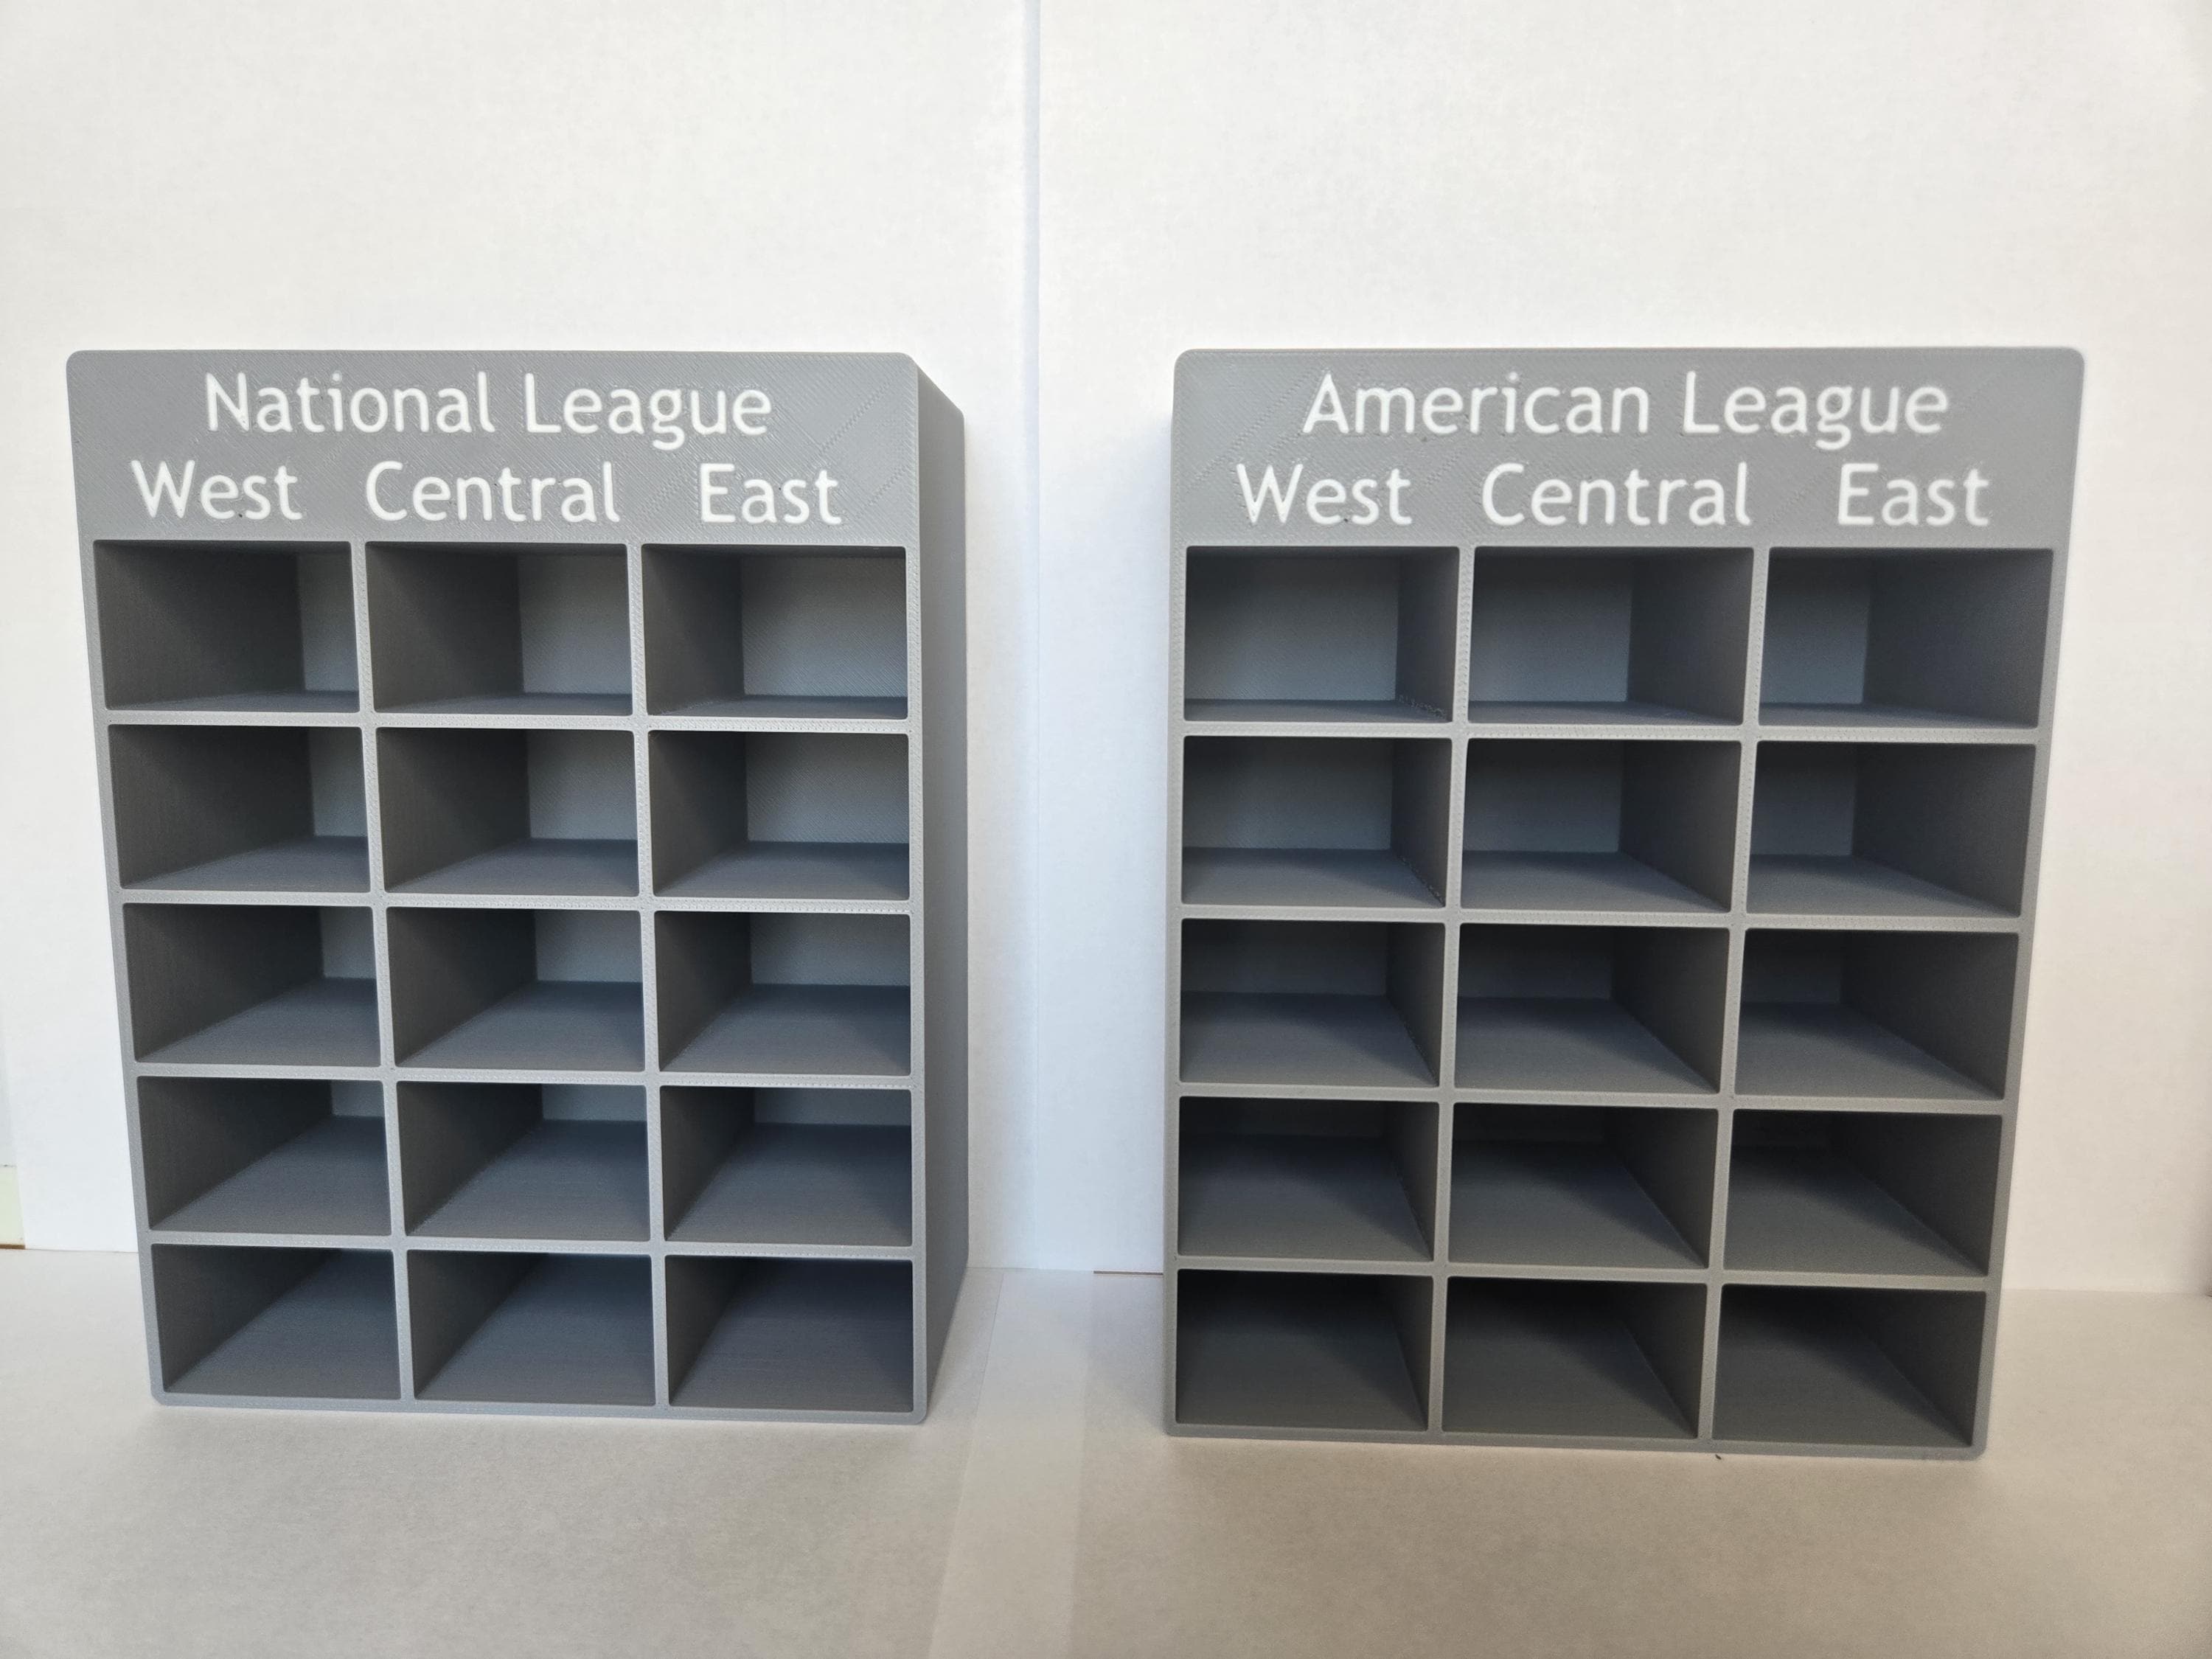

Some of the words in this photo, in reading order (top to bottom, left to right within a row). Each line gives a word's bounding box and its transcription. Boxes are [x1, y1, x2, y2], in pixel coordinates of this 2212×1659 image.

[206, 372, 495, 434] National
[524, 372, 772, 451] League
[1302, 372, 1649, 434] American
[1683, 370, 1949, 451] League
[131, 459, 302, 521] West
[366, 460, 621, 523] Central
[699, 462, 843, 526] East
[1236, 463, 1413, 526] West
[1482, 461, 1751, 526] Central
[1837, 462, 1989, 526] East
